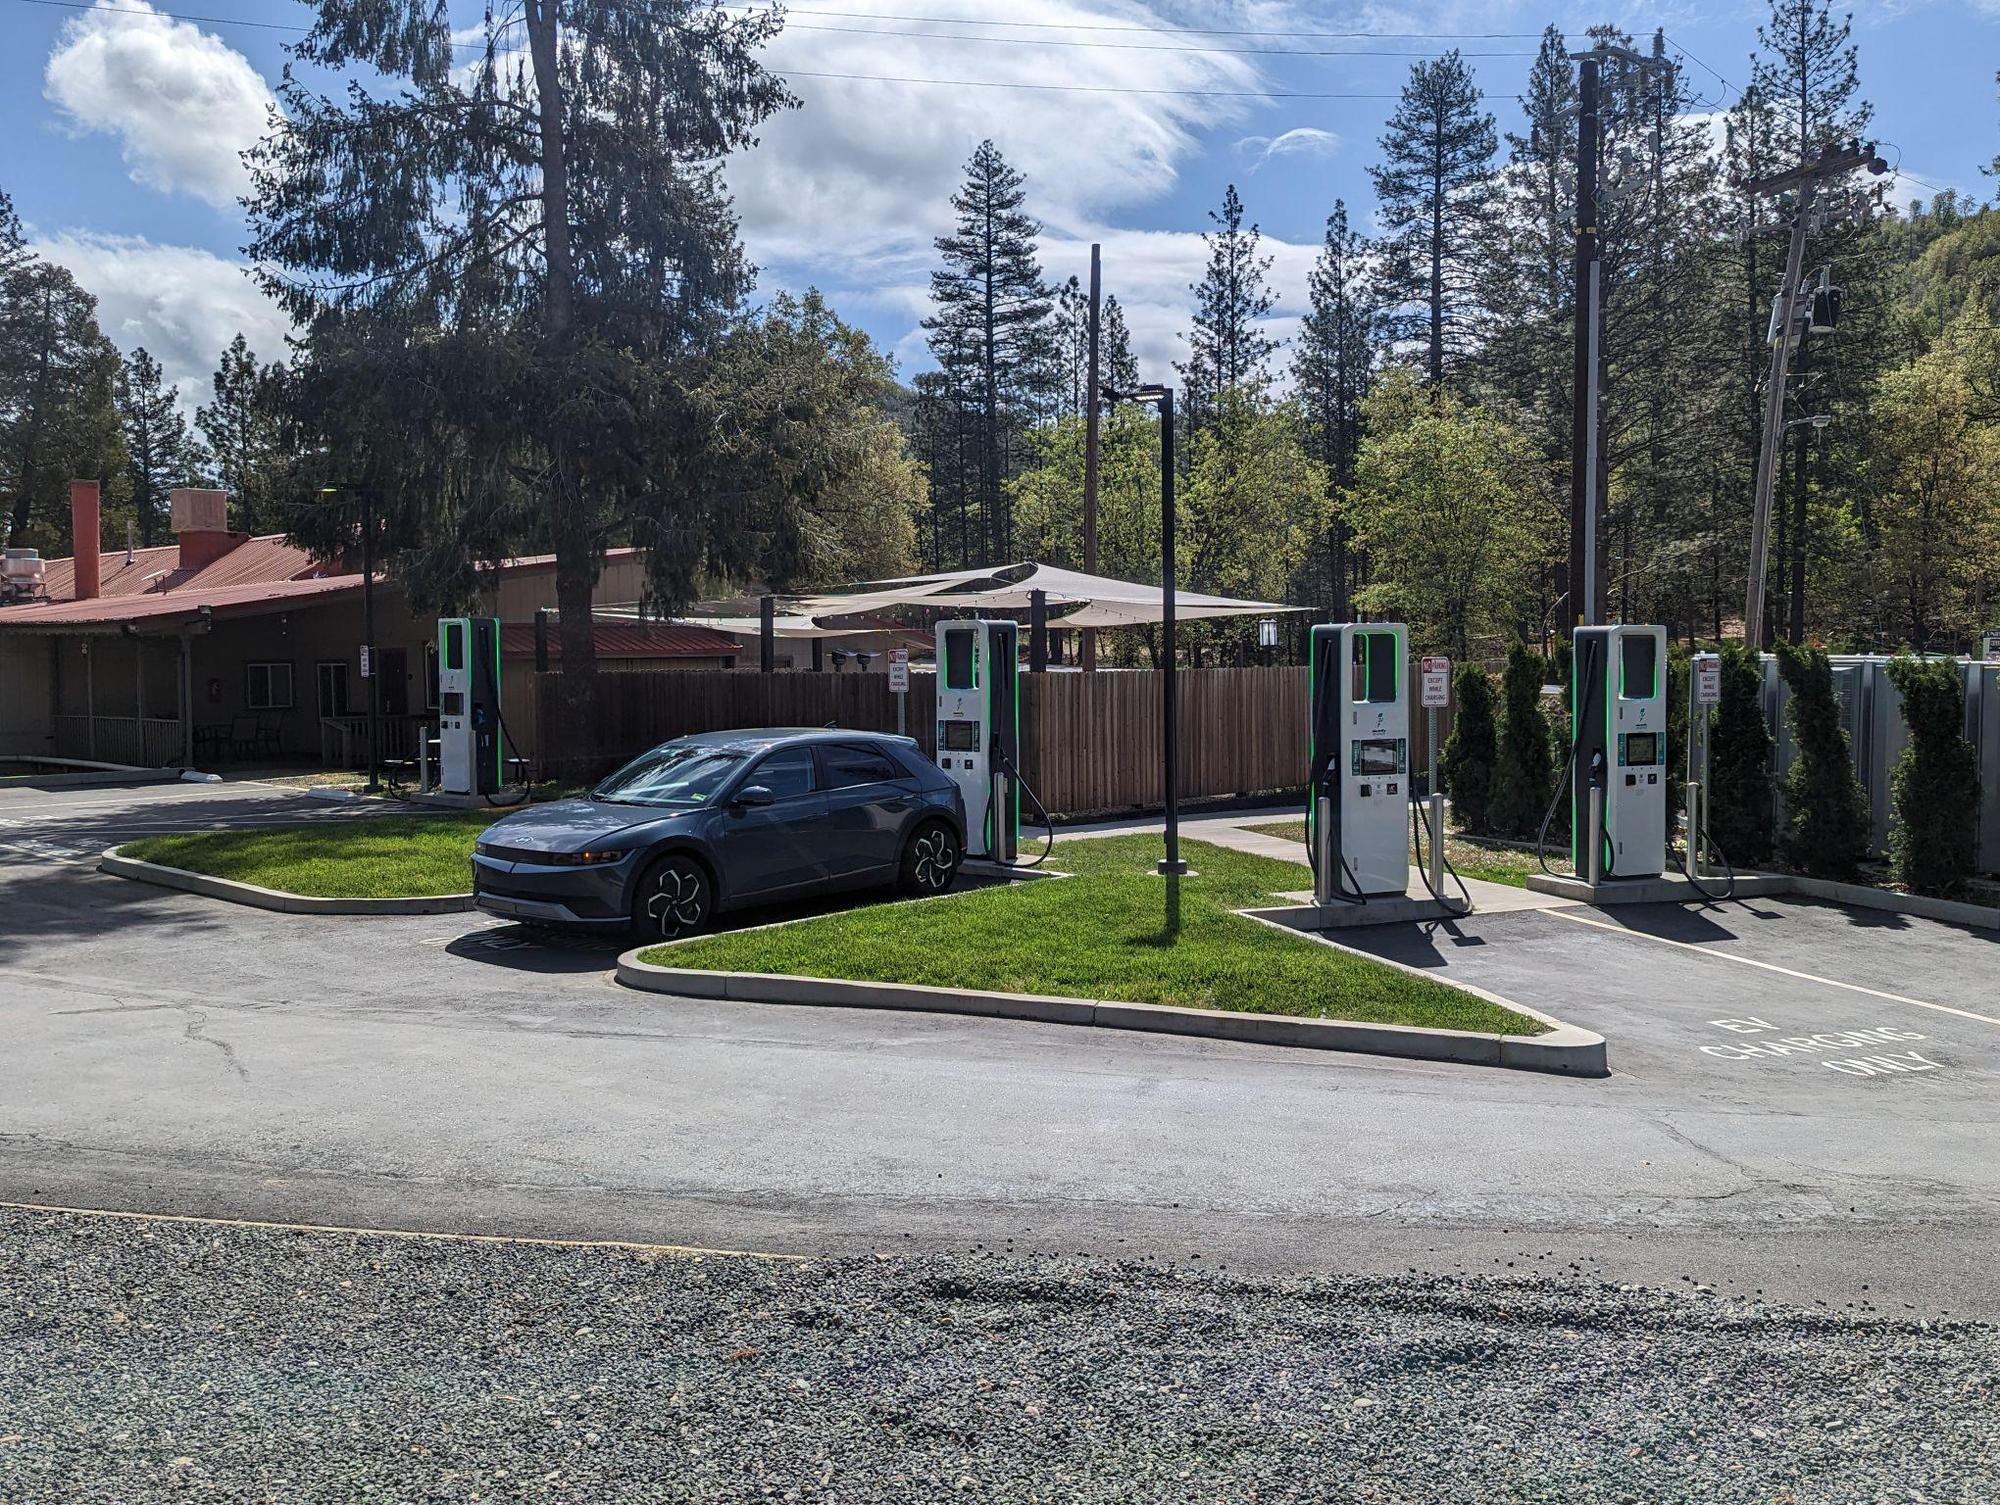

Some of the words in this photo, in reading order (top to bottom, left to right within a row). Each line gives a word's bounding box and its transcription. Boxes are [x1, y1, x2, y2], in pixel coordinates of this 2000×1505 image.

[1706, 1016, 1781, 1034] EV
[1699, 1027, 1927, 1060] CHARGING
[1820, 1051, 1946, 1077] ONLY
